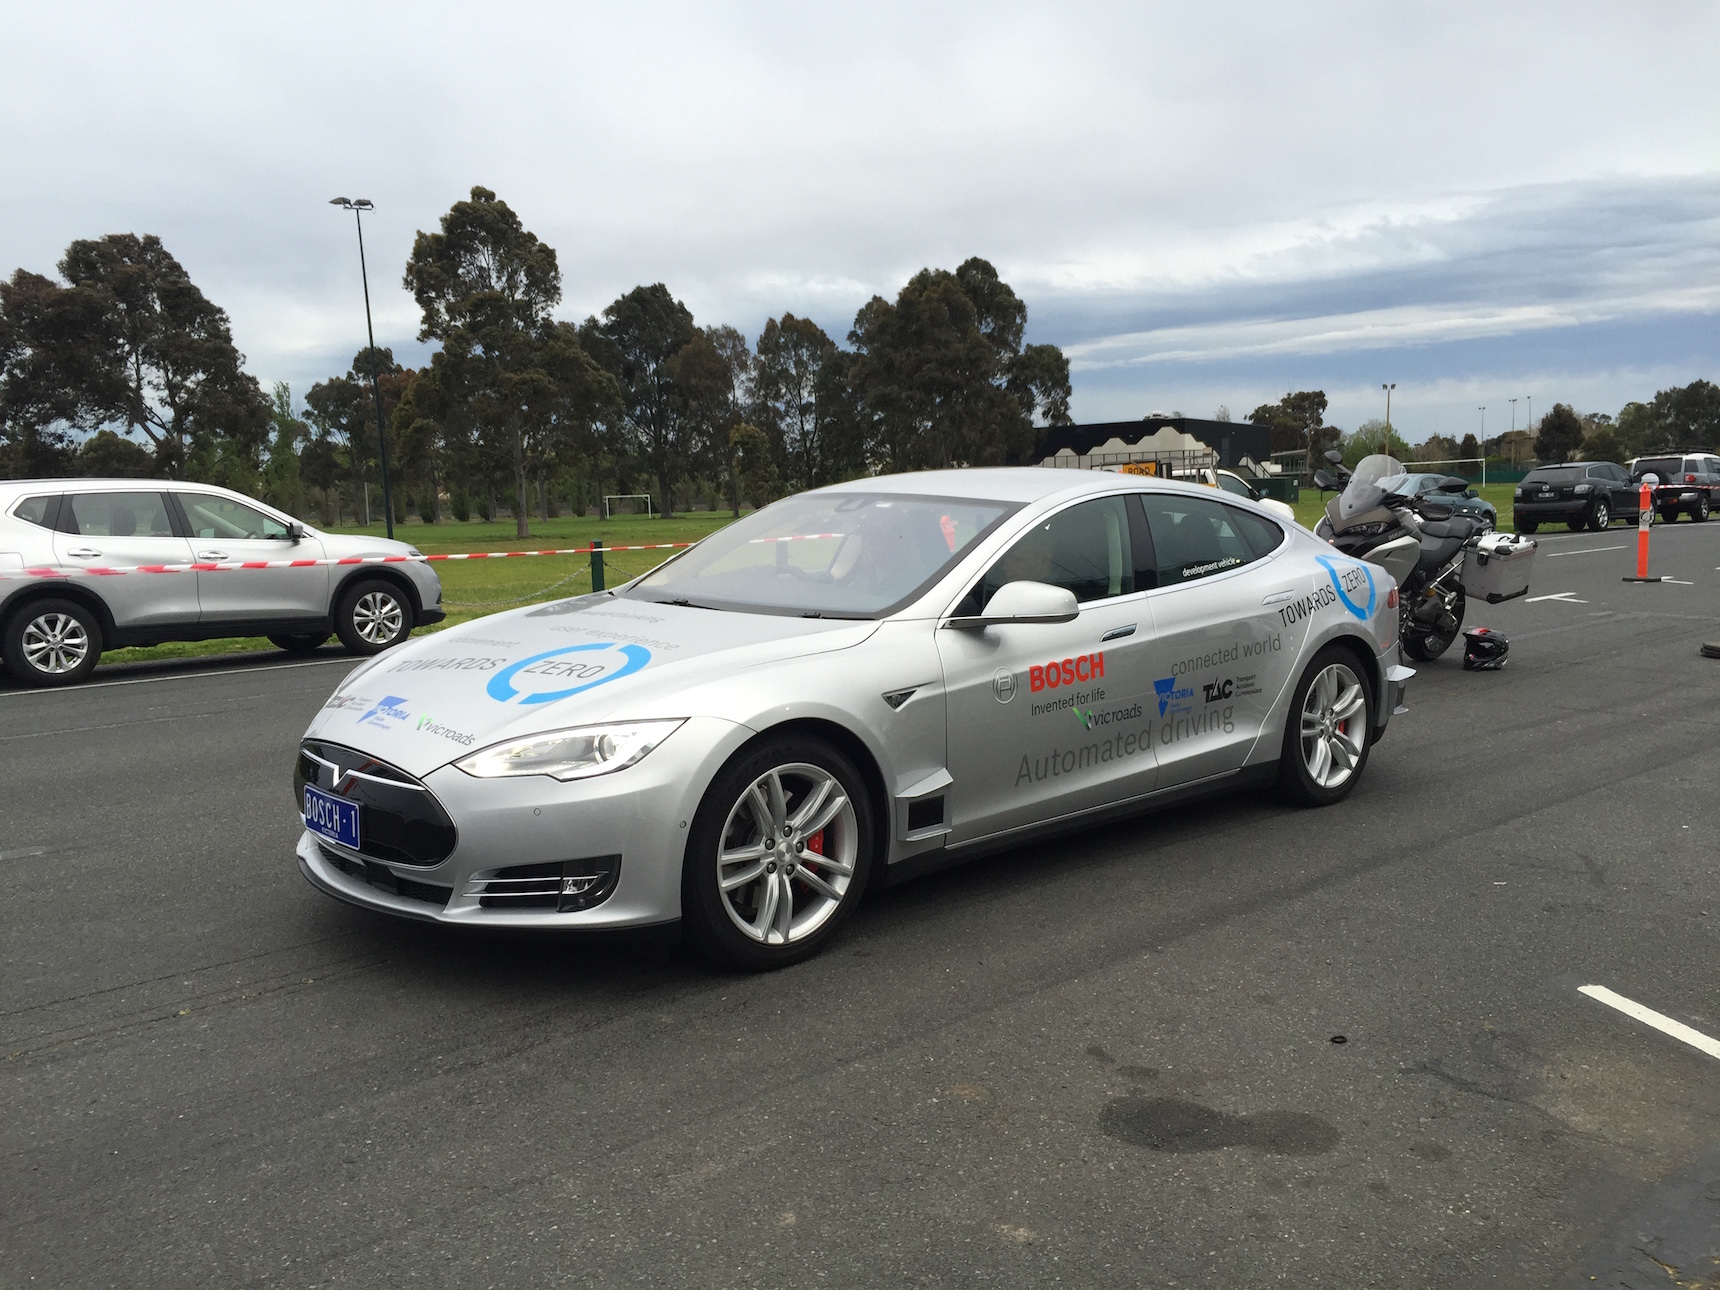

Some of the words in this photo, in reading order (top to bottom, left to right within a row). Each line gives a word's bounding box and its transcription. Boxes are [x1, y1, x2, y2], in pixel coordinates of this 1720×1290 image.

[1182, 562, 1218, 577] development
[1218, 556, 1236, 568] vehicle
[1278, 584, 1336, 627] TOWARDS
[1341, 567, 1366, 593] ZERO
[585, 628, 680, 651] experience
[386, 657, 507, 674] TOWARDS
[523, 660, 605, 679] ZERO
[1171, 643, 1238, 676] connected
[1243, 634, 1281, 657] world
[1028, 651, 1105, 693] BOSCH
[1031, 694, 1075, 716] Invented
[1075, 692, 1090, 706] for
[1091, 687, 1106, 702] life
[1203, 677, 1233, 703] TAC
[1094, 704, 1142, 726] vicroads
[425, 719, 475, 746] vicroads
[1015, 720, 1151, 787] Automated
[1160, 705, 1235, 746] driving
[306, 793, 340, 832] BOSCH
[351, 810, 356, 838] 1
